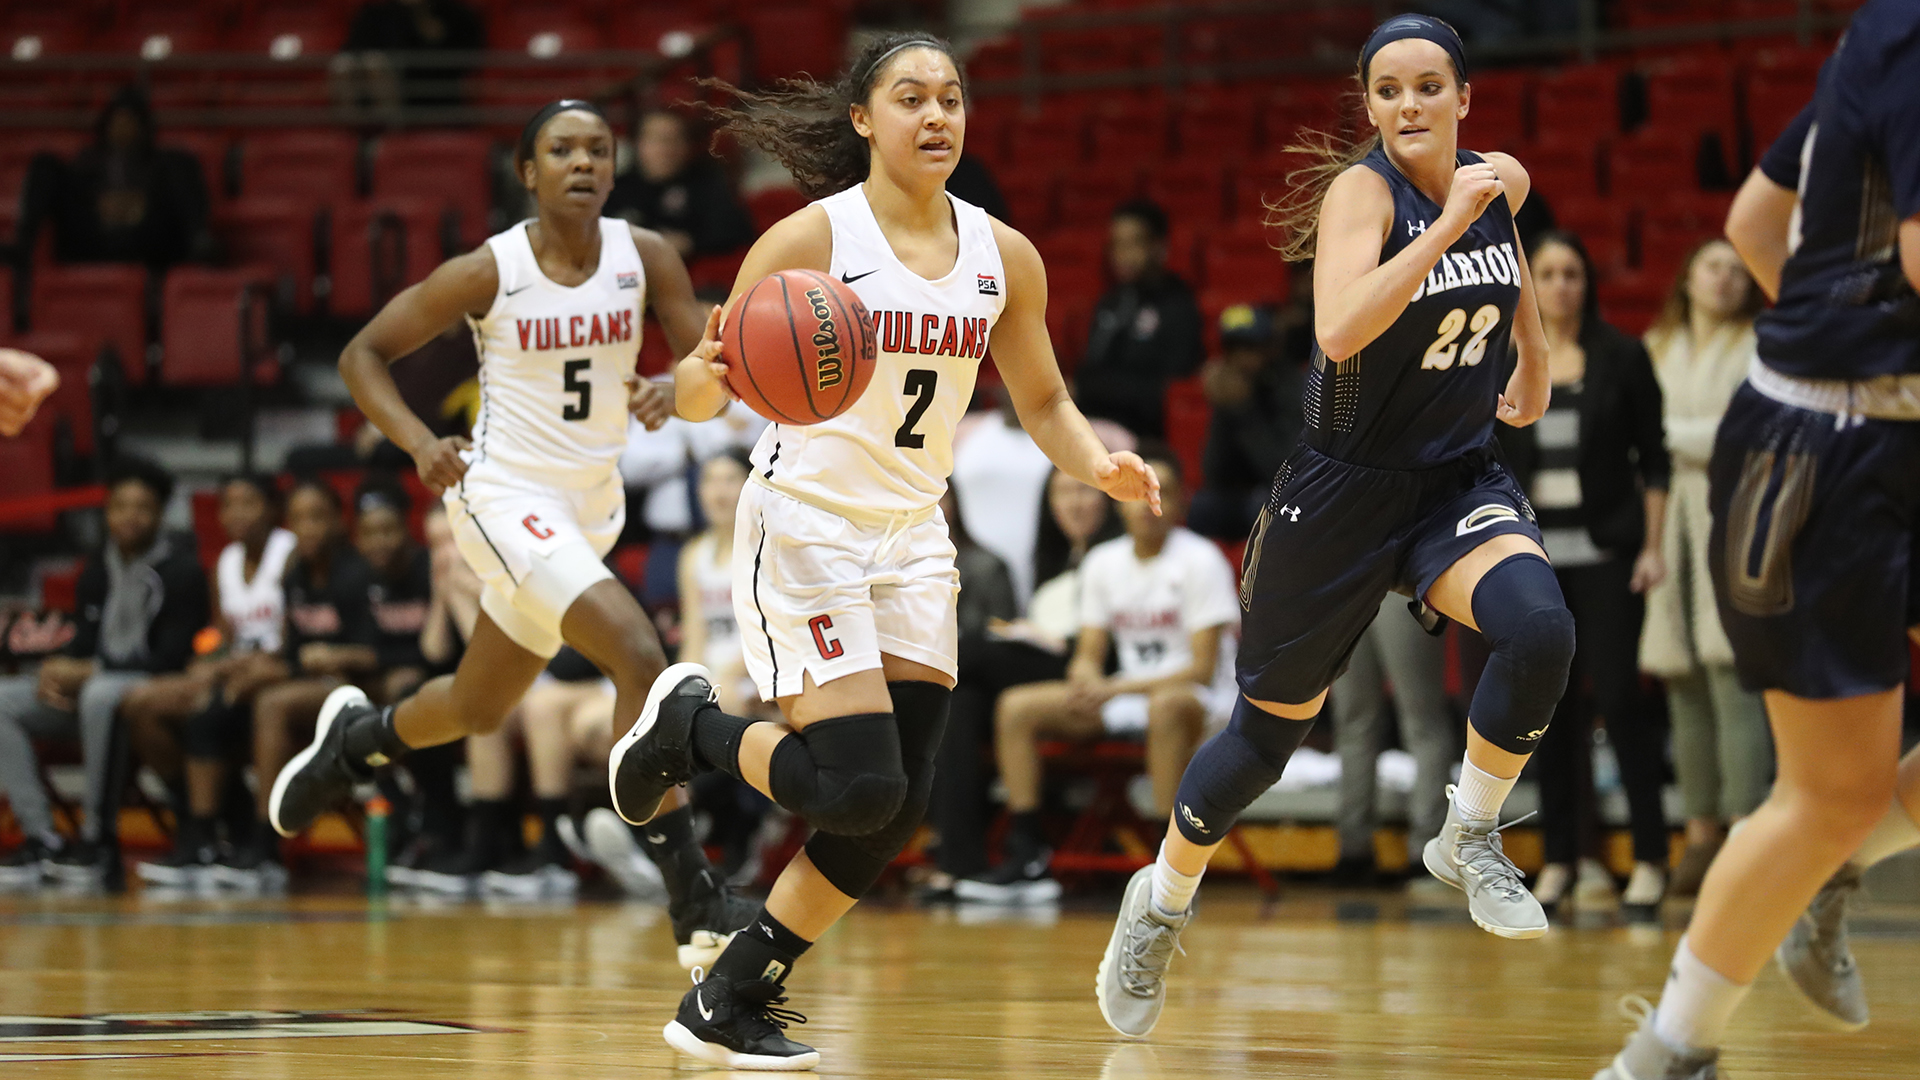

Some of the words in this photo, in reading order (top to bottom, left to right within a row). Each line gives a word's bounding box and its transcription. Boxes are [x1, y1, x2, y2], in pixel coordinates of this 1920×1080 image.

[516, 309, 632, 352] VULCANS
[804, 286, 845, 392] Wilson
[1420, 303, 1501, 372] 22
[562, 358, 592, 422] 5
[894, 368, 938, 449] 2
[522, 513, 556, 541] C
[807, 613, 845, 661] C
